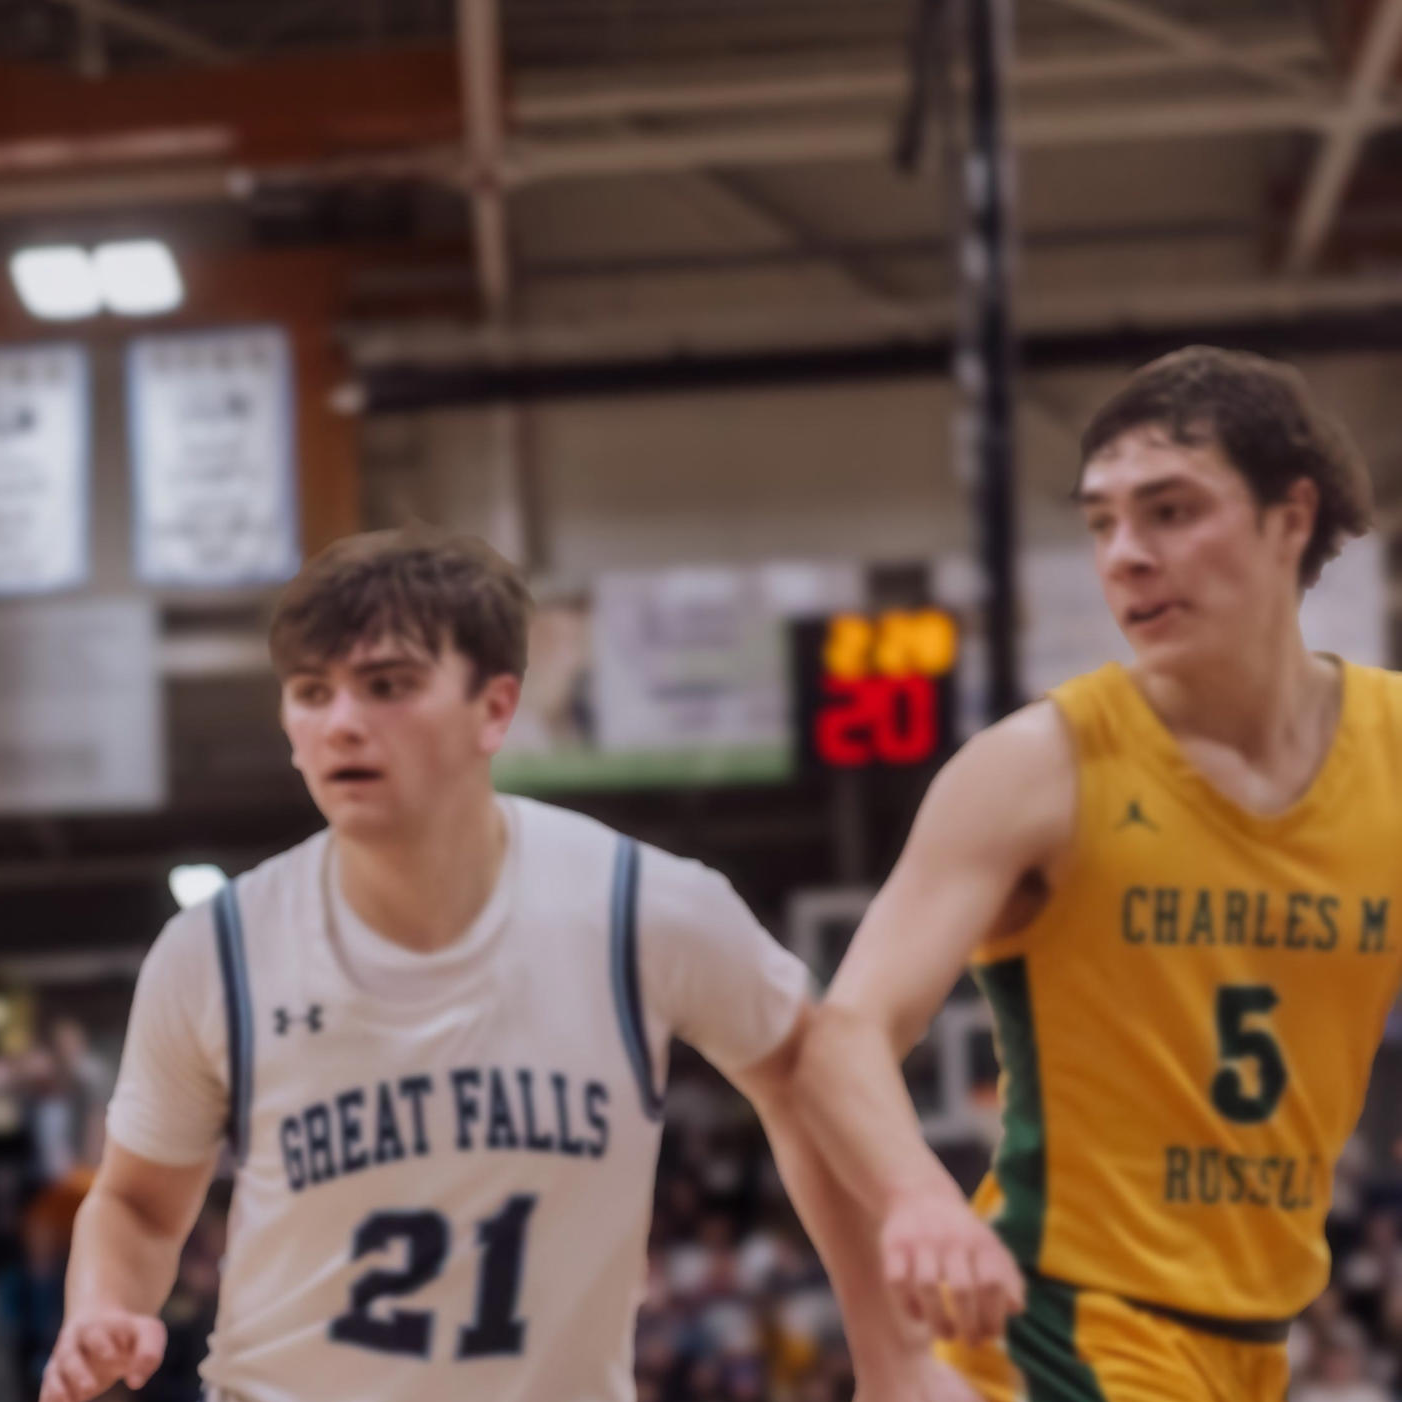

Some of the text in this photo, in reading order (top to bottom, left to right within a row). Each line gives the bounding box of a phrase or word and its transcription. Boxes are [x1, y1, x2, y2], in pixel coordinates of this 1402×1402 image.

[1121, 885, 1341, 953] CHARLES
[1210, 983, 1289, 1126] 5
[280, 1067, 610, 1193] GREAT FALLS
[326, 1192, 541, 1362] 21
